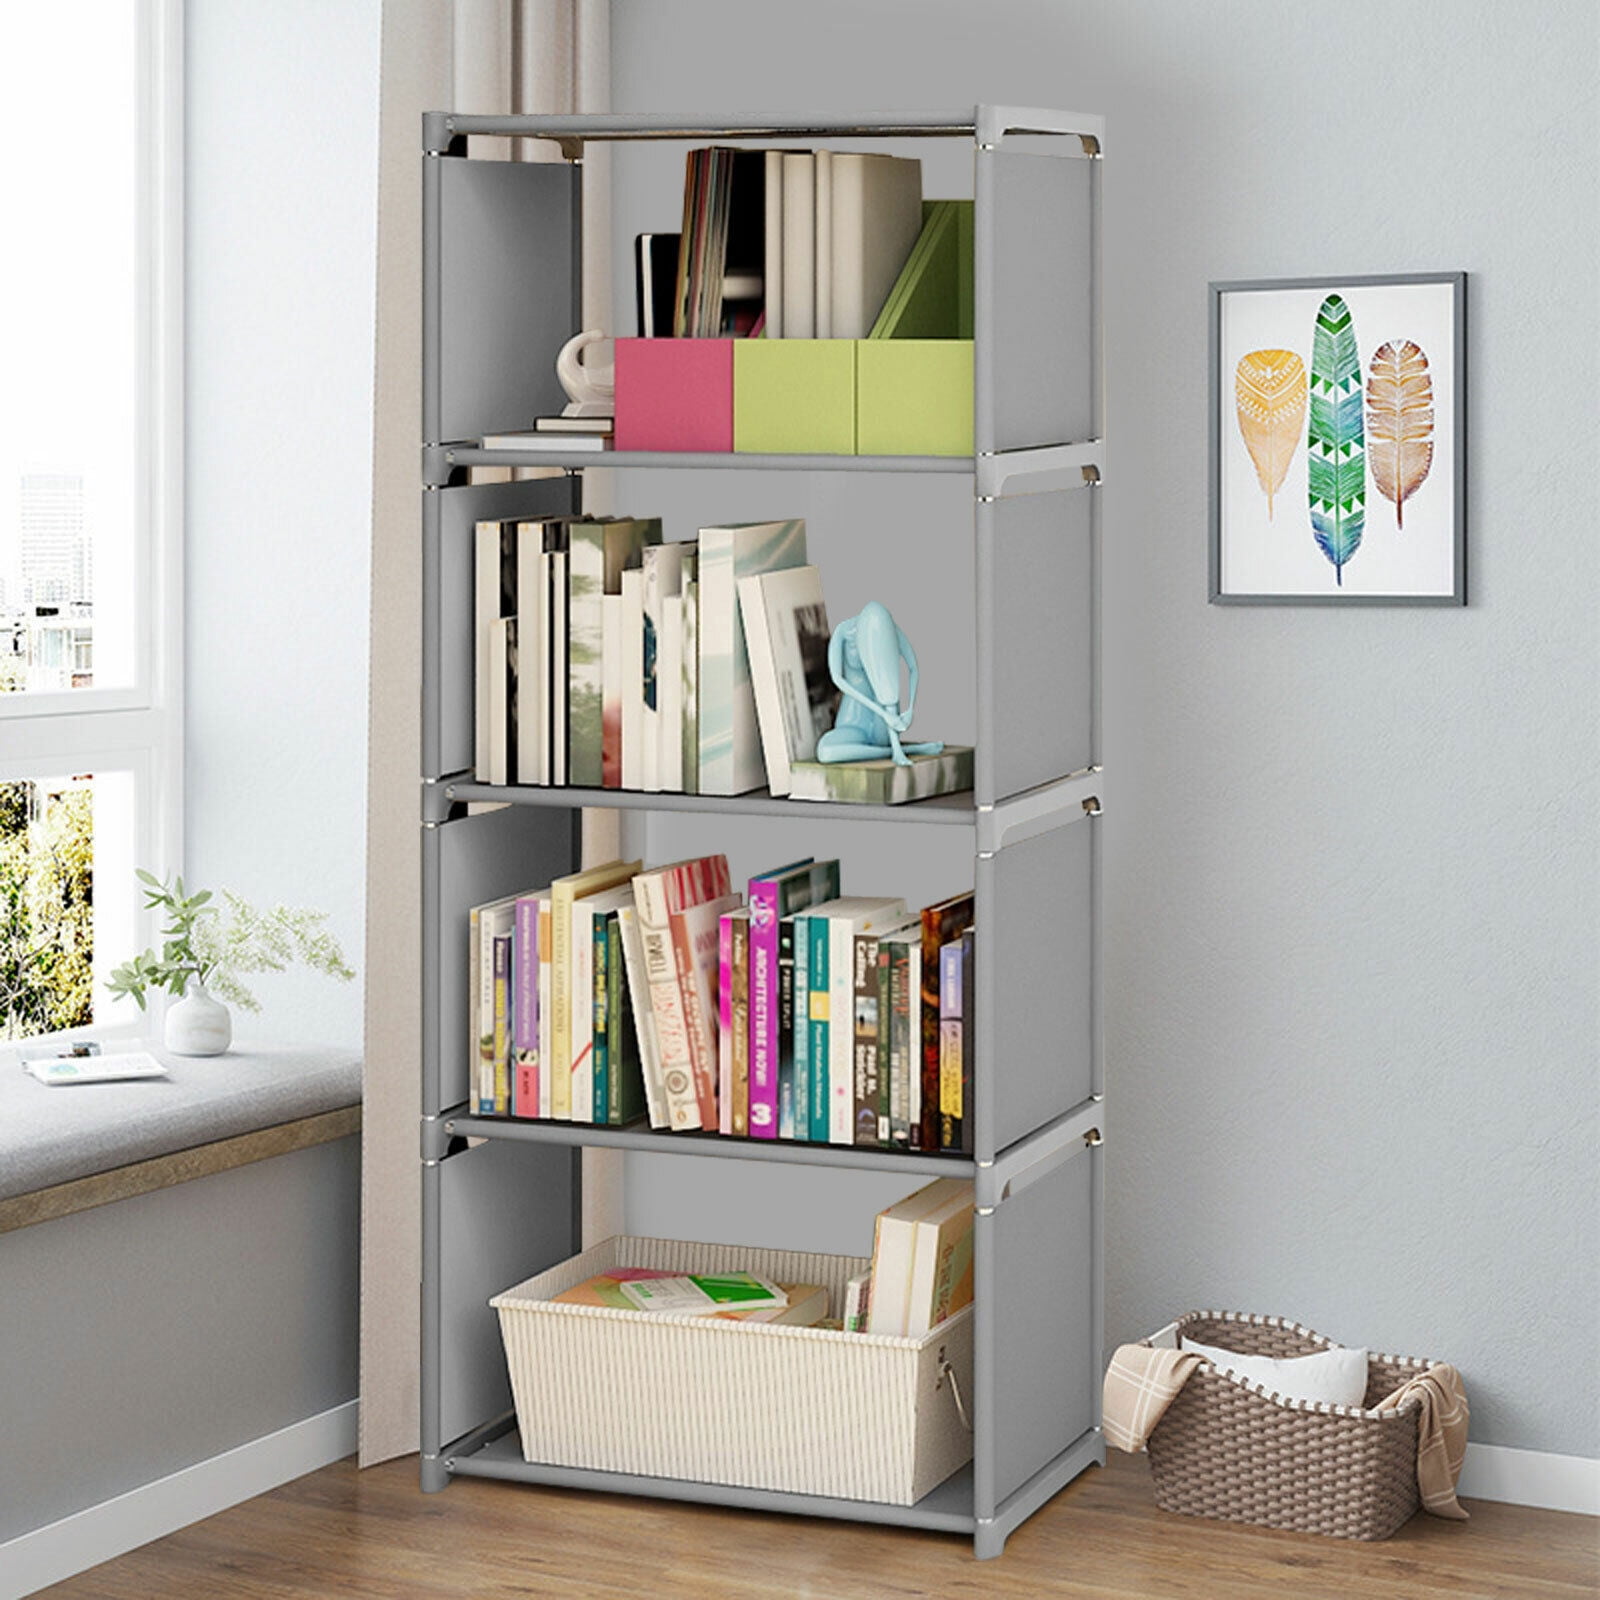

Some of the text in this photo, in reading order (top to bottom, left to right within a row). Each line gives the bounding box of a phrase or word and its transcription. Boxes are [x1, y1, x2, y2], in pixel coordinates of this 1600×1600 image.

[855, 940, 868, 989] Calling
[867, 940, 878, 968] The
[755, 945, 768, 1048] ARCHITECTURE
[866, 1044, 878, 1076] Paul
[750, 1102, 772, 1126] 3
